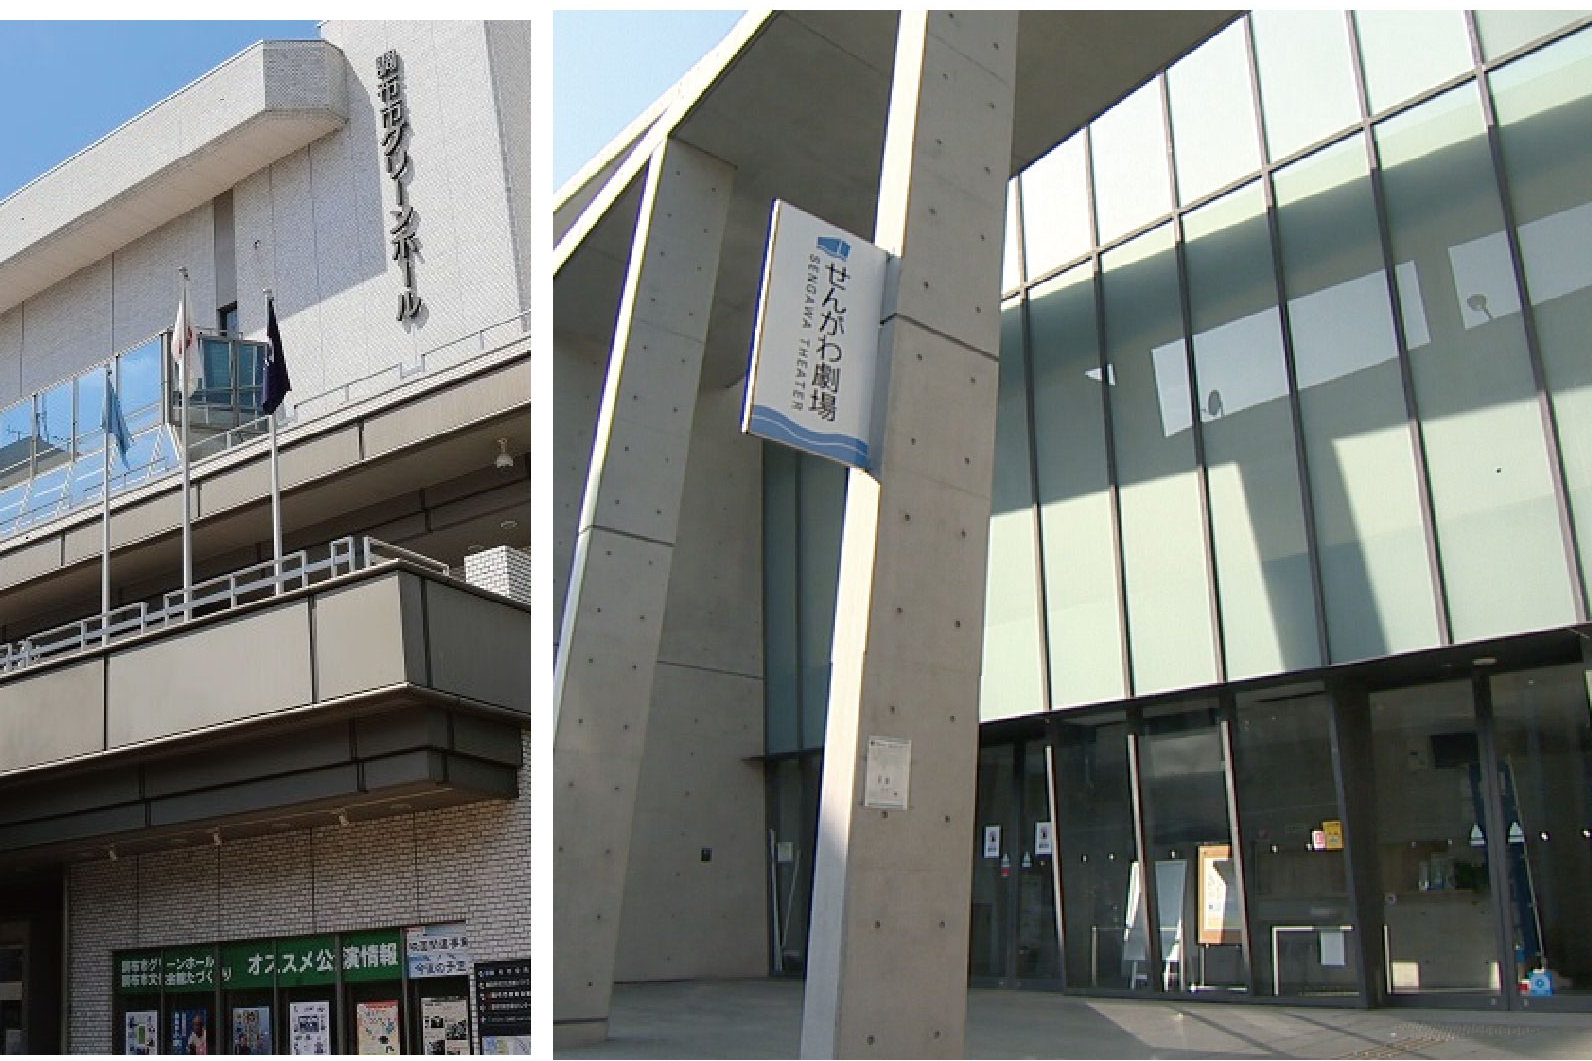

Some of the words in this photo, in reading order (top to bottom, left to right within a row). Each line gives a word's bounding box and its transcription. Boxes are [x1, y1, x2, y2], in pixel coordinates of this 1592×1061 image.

[376, 49, 422, 320] 調布市グリーンホール
[802, 253, 821, 329] SENGAWA
[792, 338, 811, 411] THEATER
[809, 263, 850, 422] せんがわ劇場
[248, 942, 399, 976] オススメ公演情報
